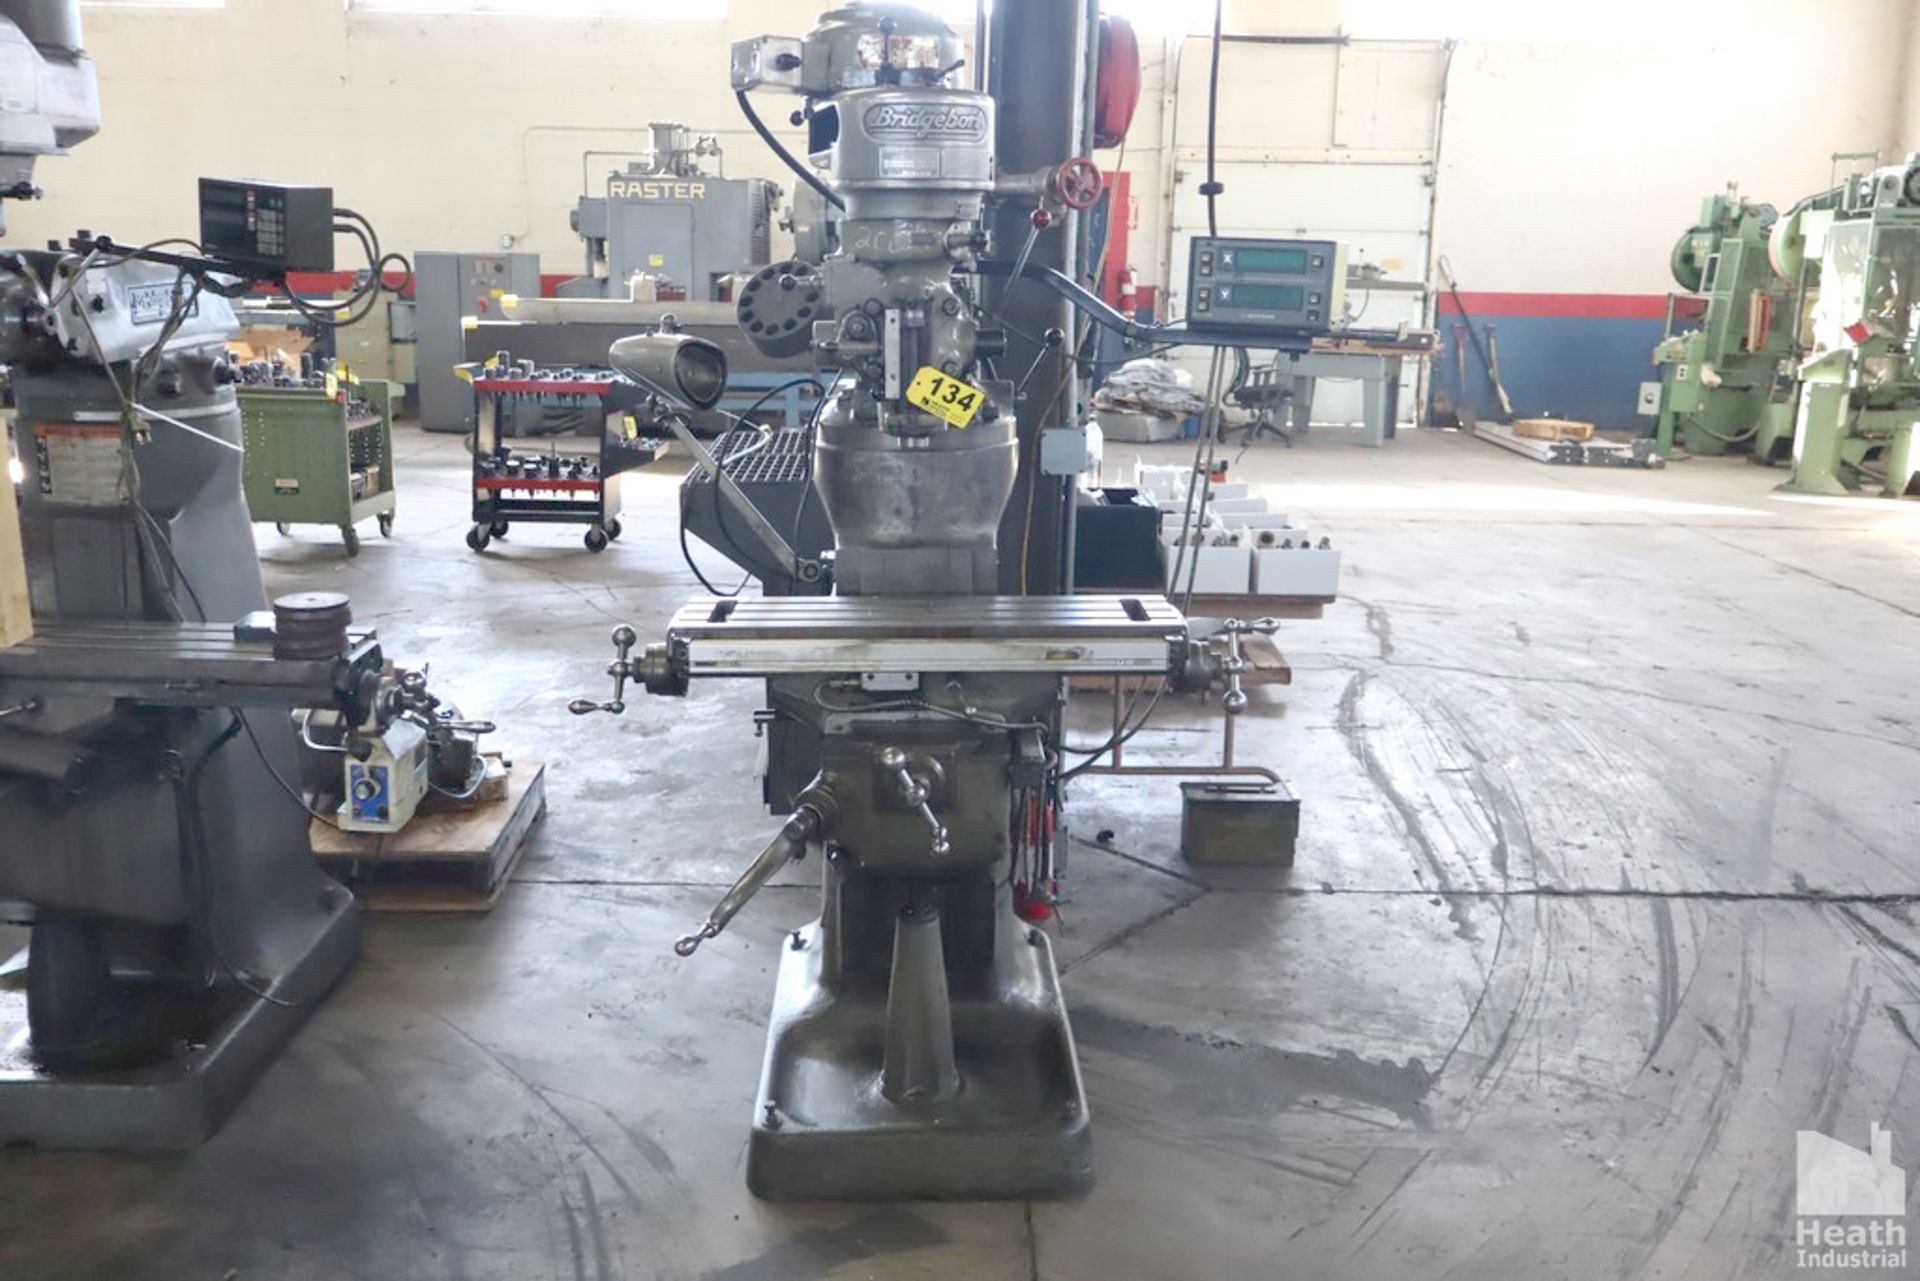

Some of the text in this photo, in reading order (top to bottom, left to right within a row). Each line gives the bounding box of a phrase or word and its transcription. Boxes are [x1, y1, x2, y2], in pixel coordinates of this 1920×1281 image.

[871, 106, 983, 138] Bridgeport
[609, 181, 705, 199] RASTER
[1222, 253, 1233, 265] X
[1220, 289, 1230, 300] Y
[930, 377, 977, 412] 134
